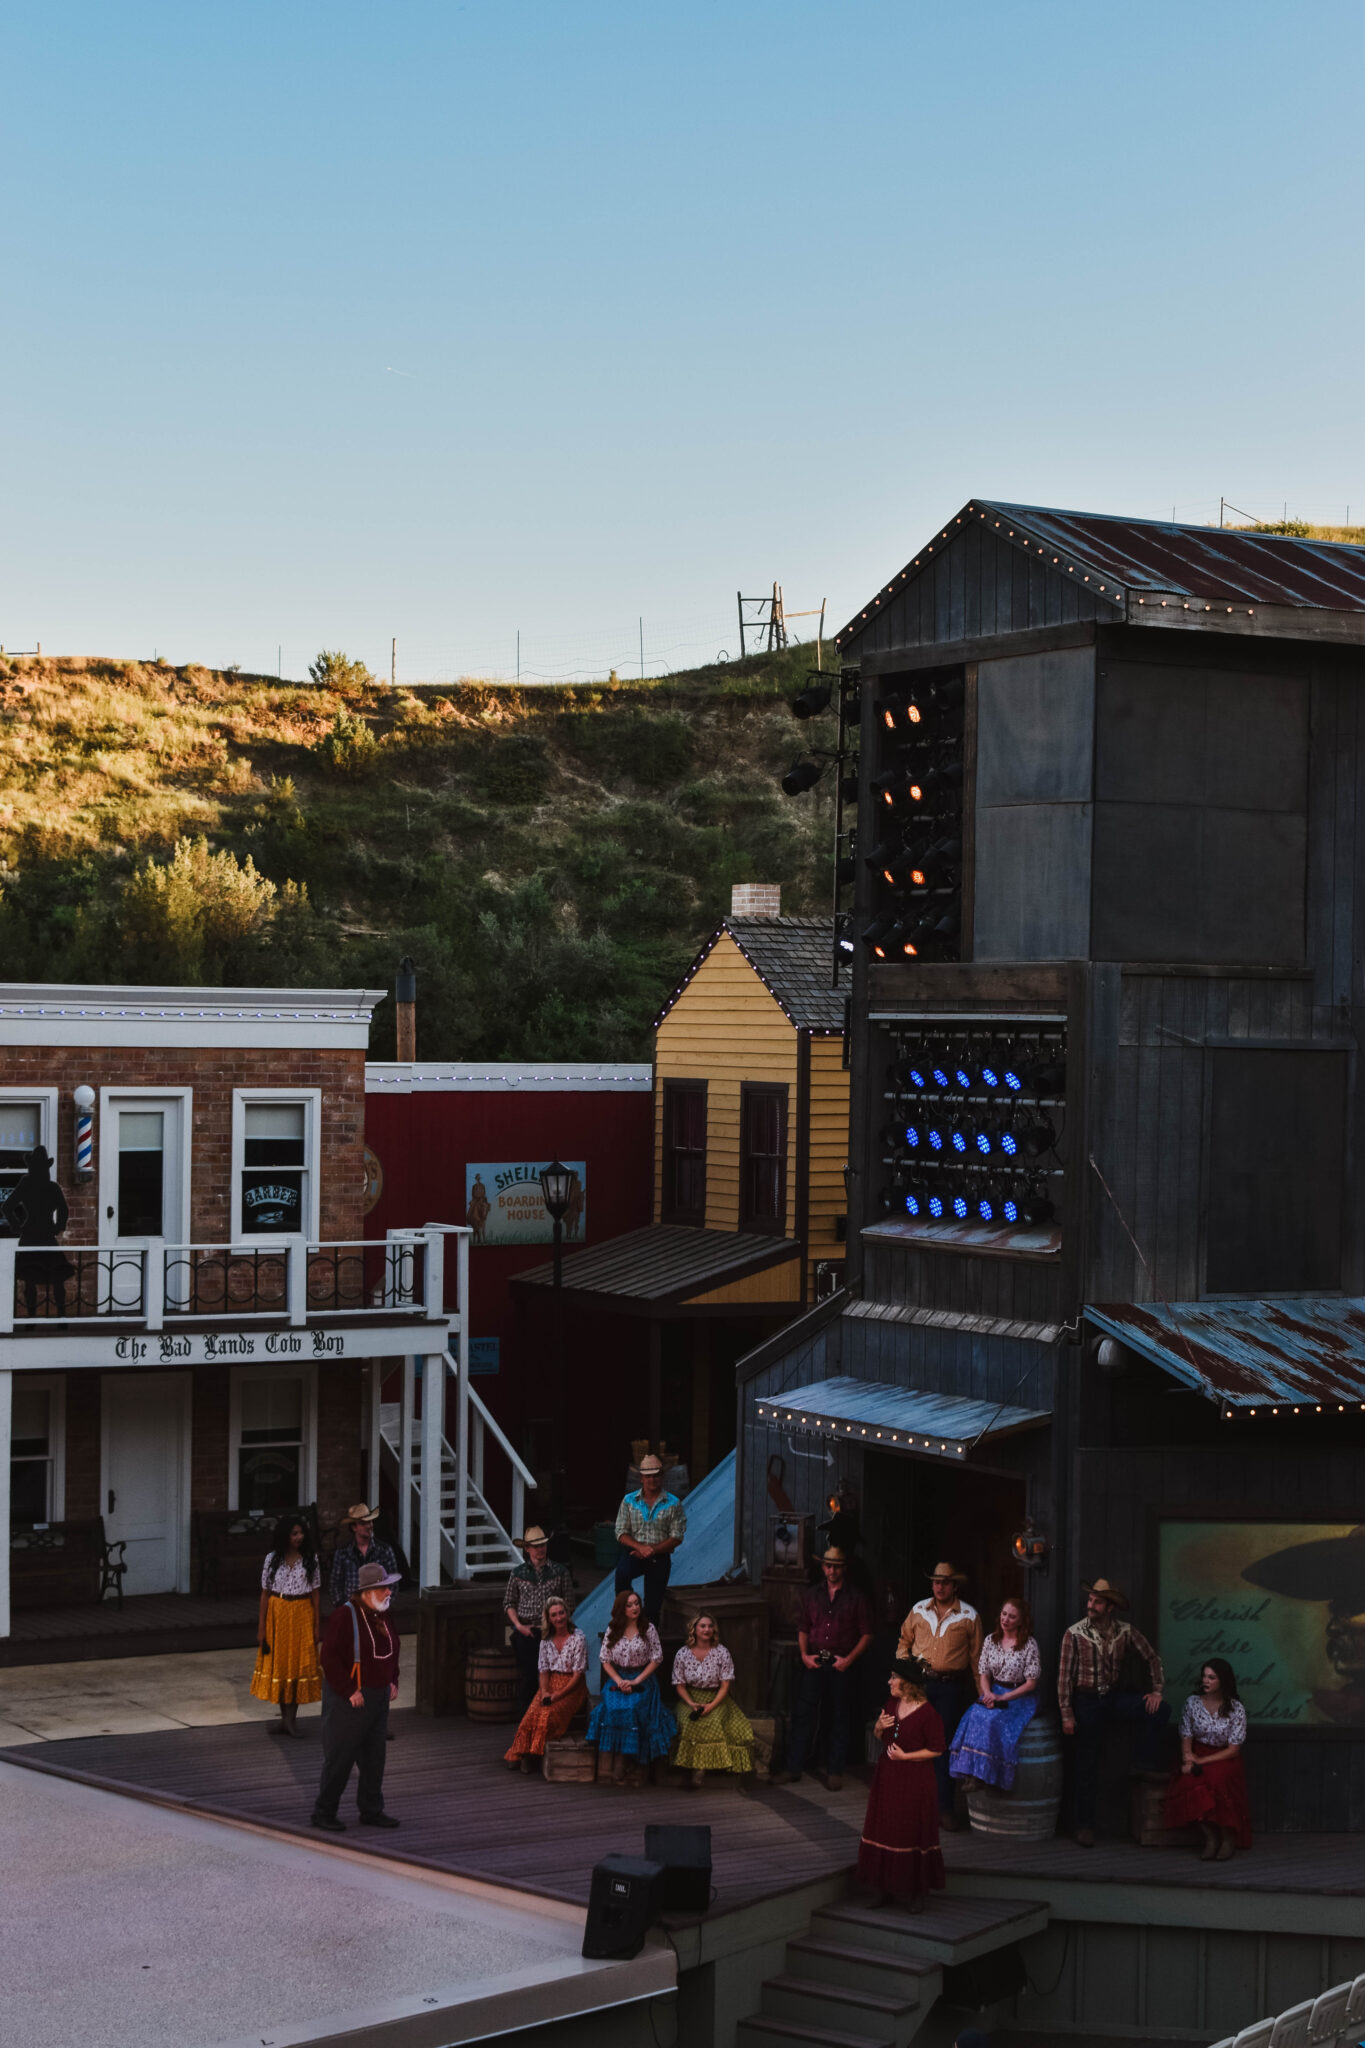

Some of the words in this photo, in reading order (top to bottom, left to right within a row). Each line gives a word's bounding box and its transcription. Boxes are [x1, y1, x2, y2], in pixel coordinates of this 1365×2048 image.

[494, 1166, 542, 1190] SHEIL
[245, 1184, 298, 1208] BARBER
[498, 1195, 546, 1208] BOARDIN
[507, 1209, 545, 1221] HOUSE
[115, 1336, 147, 1364] The
[158, 1335, 191, 1363] Bad
[203, 1333, 255, 1360] Lands
[265, 1331, 302, 1355] Cow
[311, 1330, 344, 1357] Boy
[1190, 1630, 1253, 1657] these
